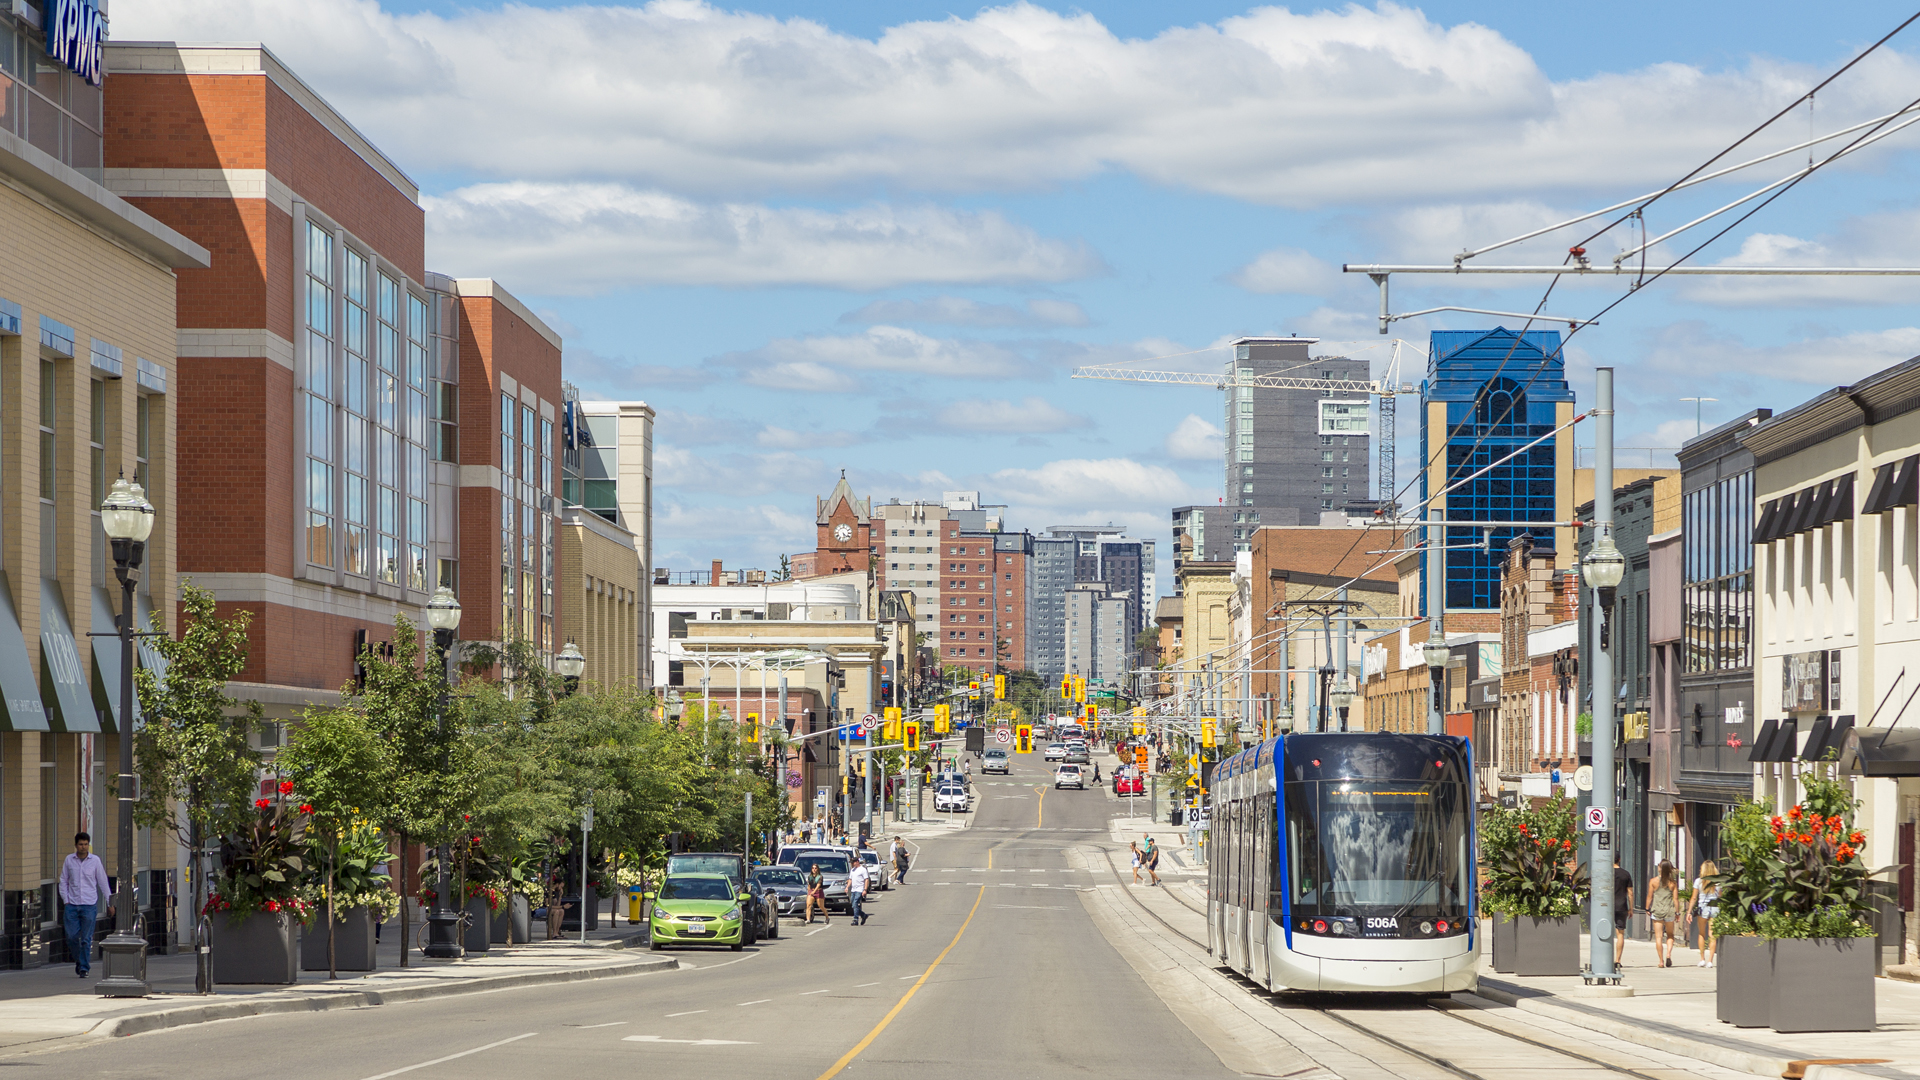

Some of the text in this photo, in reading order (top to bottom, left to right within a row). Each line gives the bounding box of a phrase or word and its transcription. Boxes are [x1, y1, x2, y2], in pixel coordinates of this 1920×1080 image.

[53, 0, 103, 86] KPMG
[45, 632, 82, 685] LCBO
[1367, 917, 1398, 928] 506A
